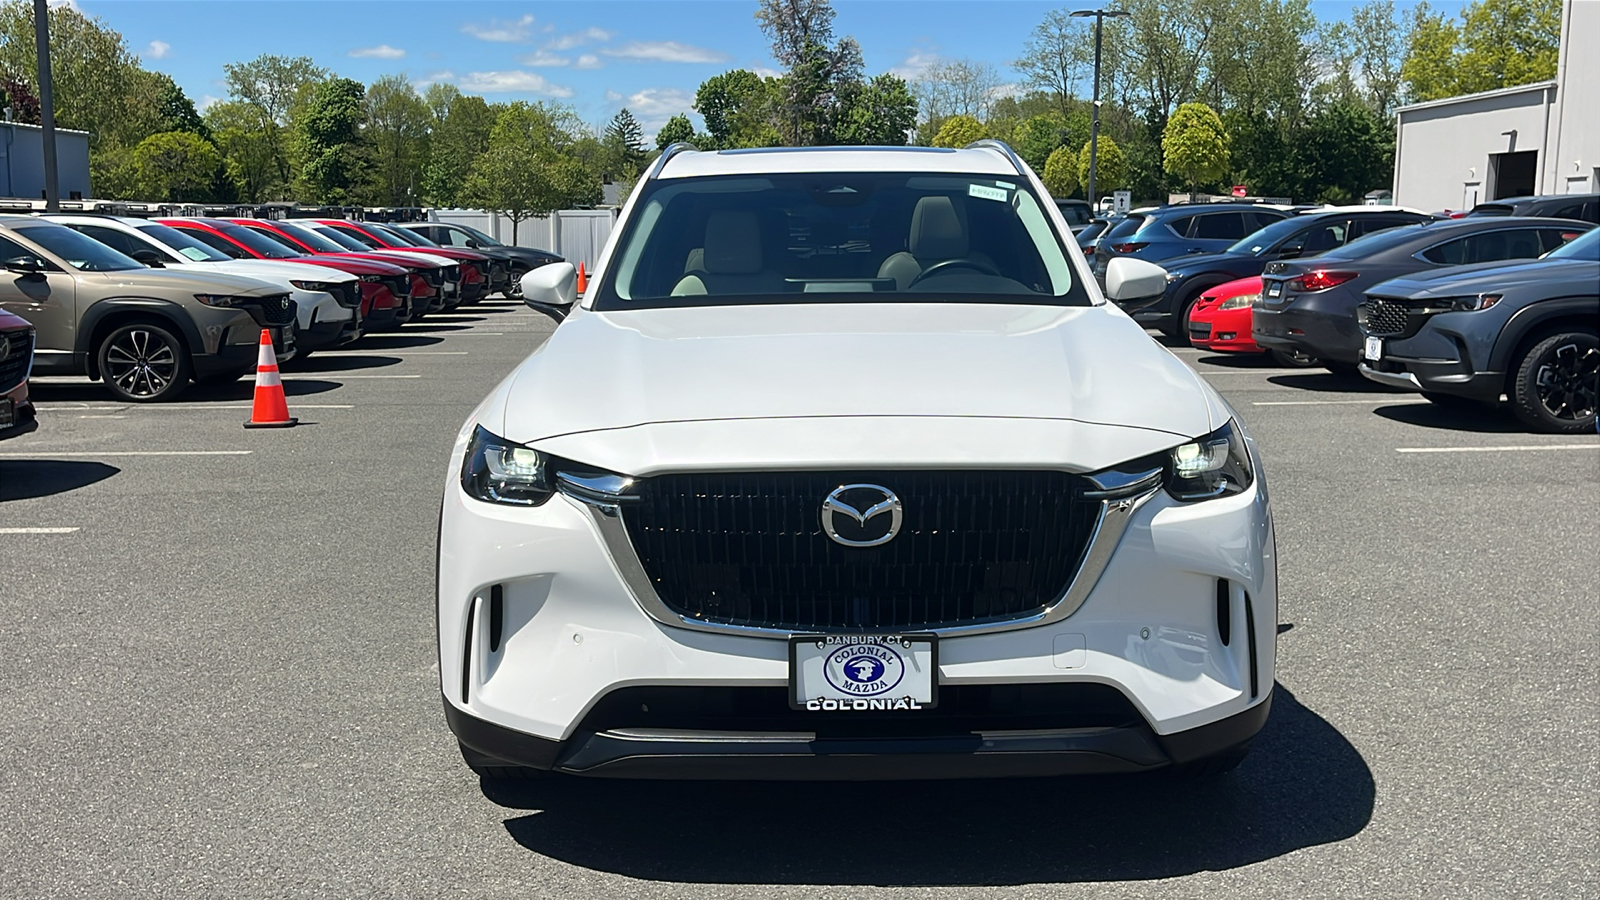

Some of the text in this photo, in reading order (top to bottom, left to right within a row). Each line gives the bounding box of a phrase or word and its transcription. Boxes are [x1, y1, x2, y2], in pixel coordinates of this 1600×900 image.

[826, 635, 902, 645] DANBURY, CT
[834, 646, 894, 665] COLONIAL
[842, 680, 888, 693] MAZDA
[806, 700, 922, 710] COLONIAL
